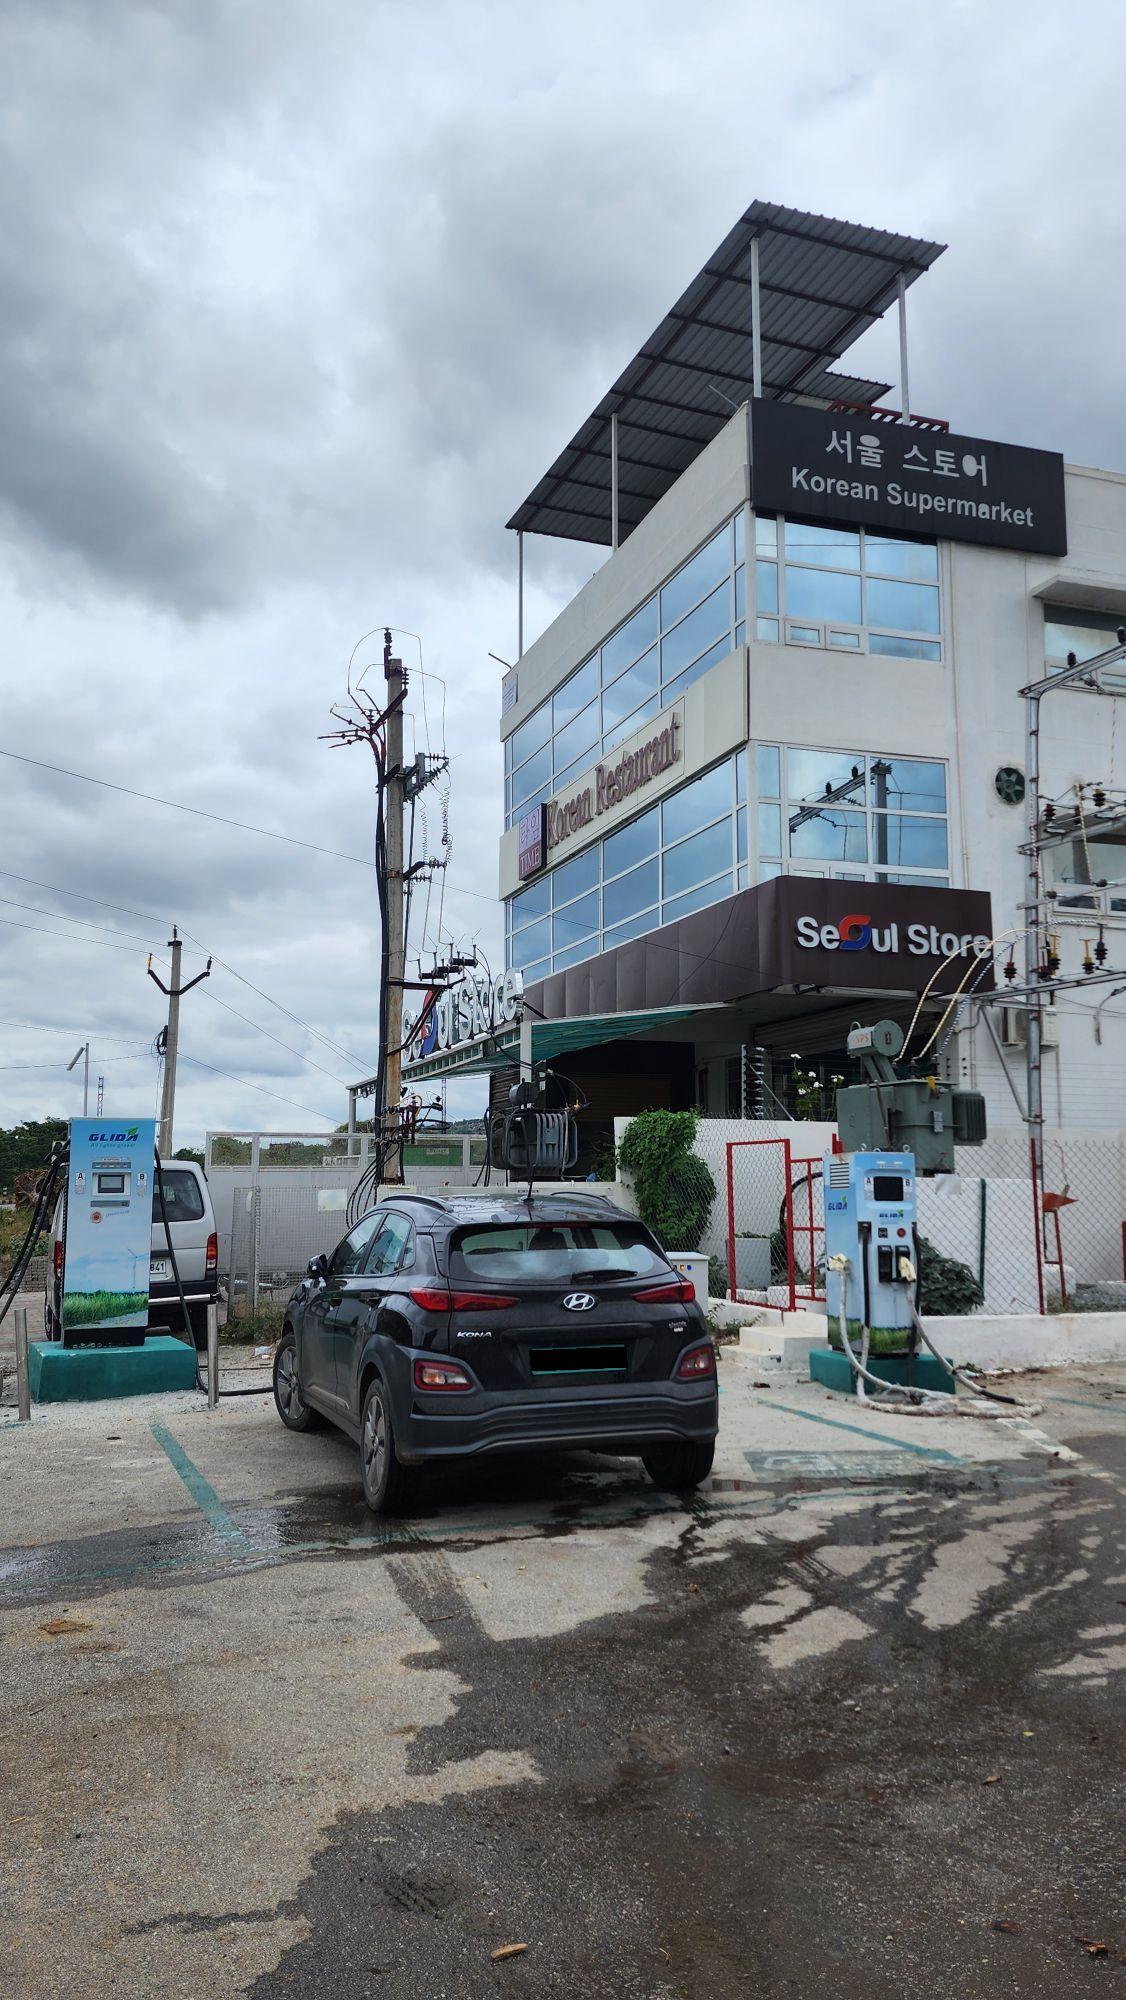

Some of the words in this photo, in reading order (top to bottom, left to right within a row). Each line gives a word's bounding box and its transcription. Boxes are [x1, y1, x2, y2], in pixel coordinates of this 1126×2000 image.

[825, 430, 885, 468] 서울
[902, 444, 988, 486] 스토어
[791, 466, 879, 501] Korean
[886, 483, 1034, 528] Supermarket
[547, 787, 594, 850] Korean
[595, 712, 680, 816] Restaurant
[520, 846, 540, 874] TIME
[907, 923, 992, 959] Store
[88, 1132, 139, 1142] GLIDA
[150, 1263, 164, 1272] 841
